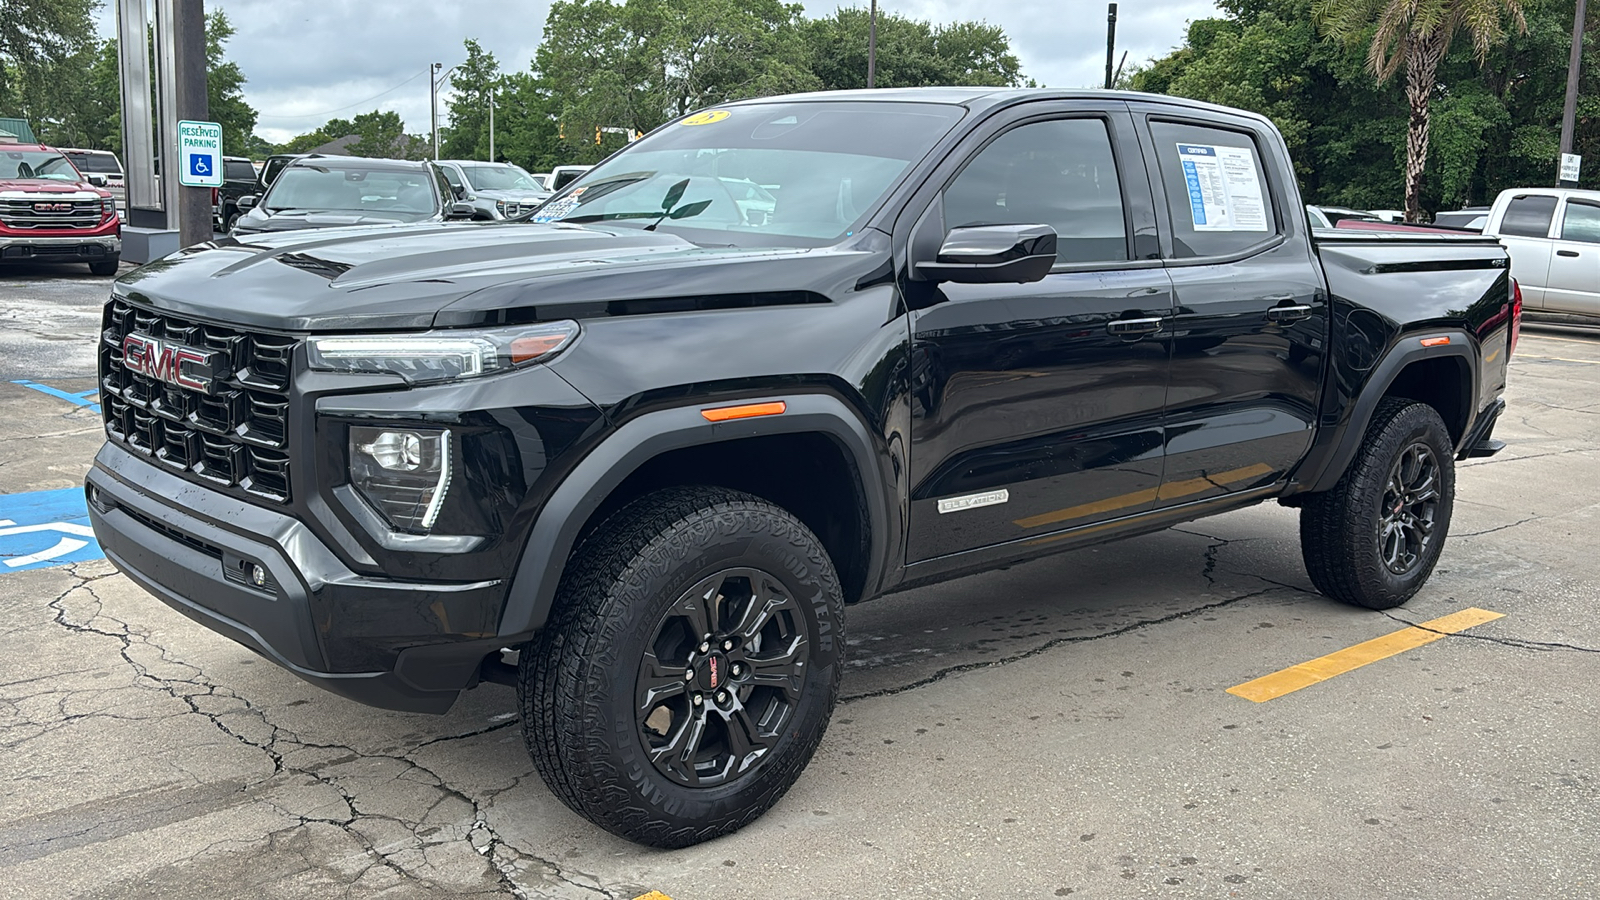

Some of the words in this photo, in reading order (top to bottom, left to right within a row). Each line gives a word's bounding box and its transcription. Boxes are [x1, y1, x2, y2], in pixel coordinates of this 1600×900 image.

[181, 127, 219, 138] RESERVED
[184, 138, 217, 149] PARKING
[34, 203, 72, 211] GMC
[123, 333, 212, 395] GMC
[944, 492, 1004, 510] ELEVATION
[709, 656, 717, 688] GMC
